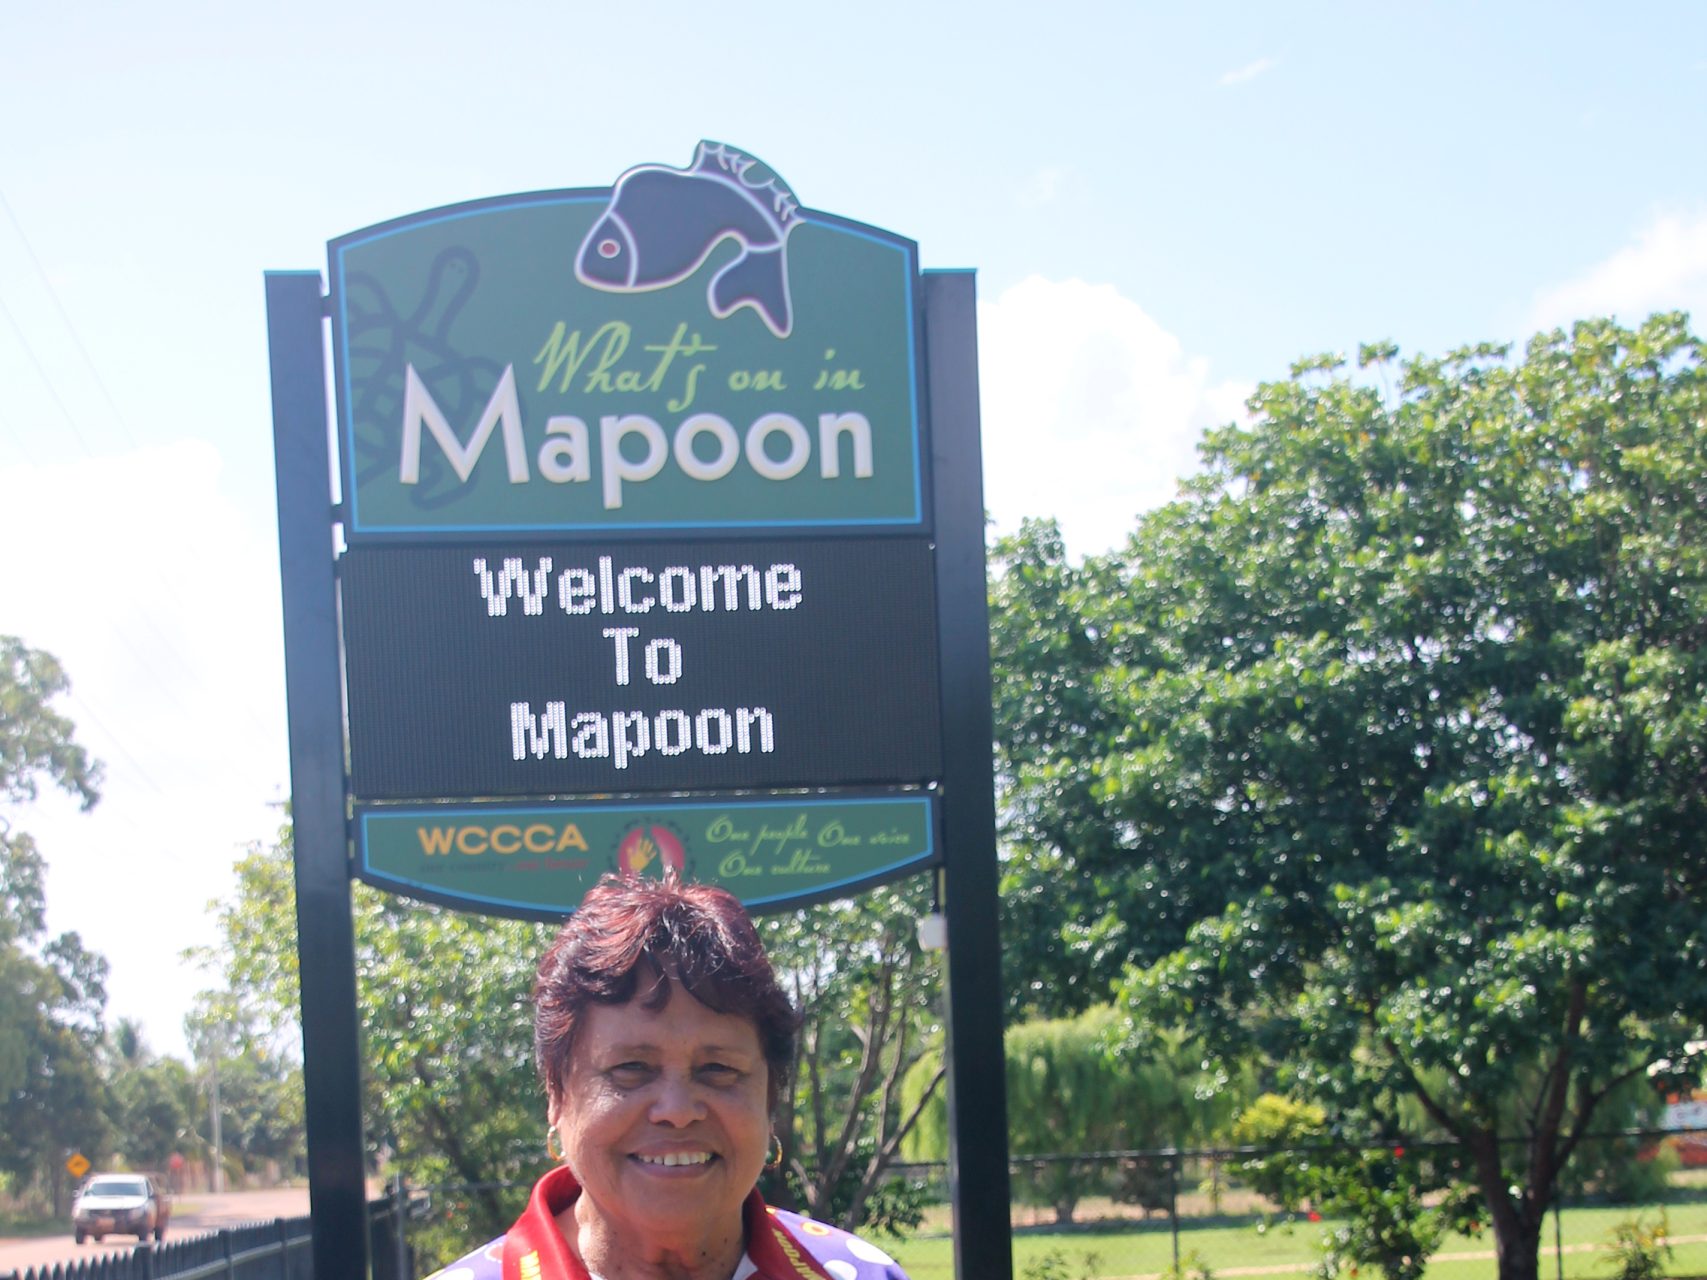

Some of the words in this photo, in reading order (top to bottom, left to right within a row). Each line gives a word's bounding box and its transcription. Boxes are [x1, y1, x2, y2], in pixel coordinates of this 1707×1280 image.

[533, 320, 717, 412] What's
[728, 370, 787, 392] on
[814, 348, 866, 390] in
[399, 363, 874, 510] Mapoon
[473, 555, 803, 617] Welcome
[602, 626, 682, 685] To
[510, 700, 775, 770] Mapoon
[417, 823, 590, 856] WCCCA
